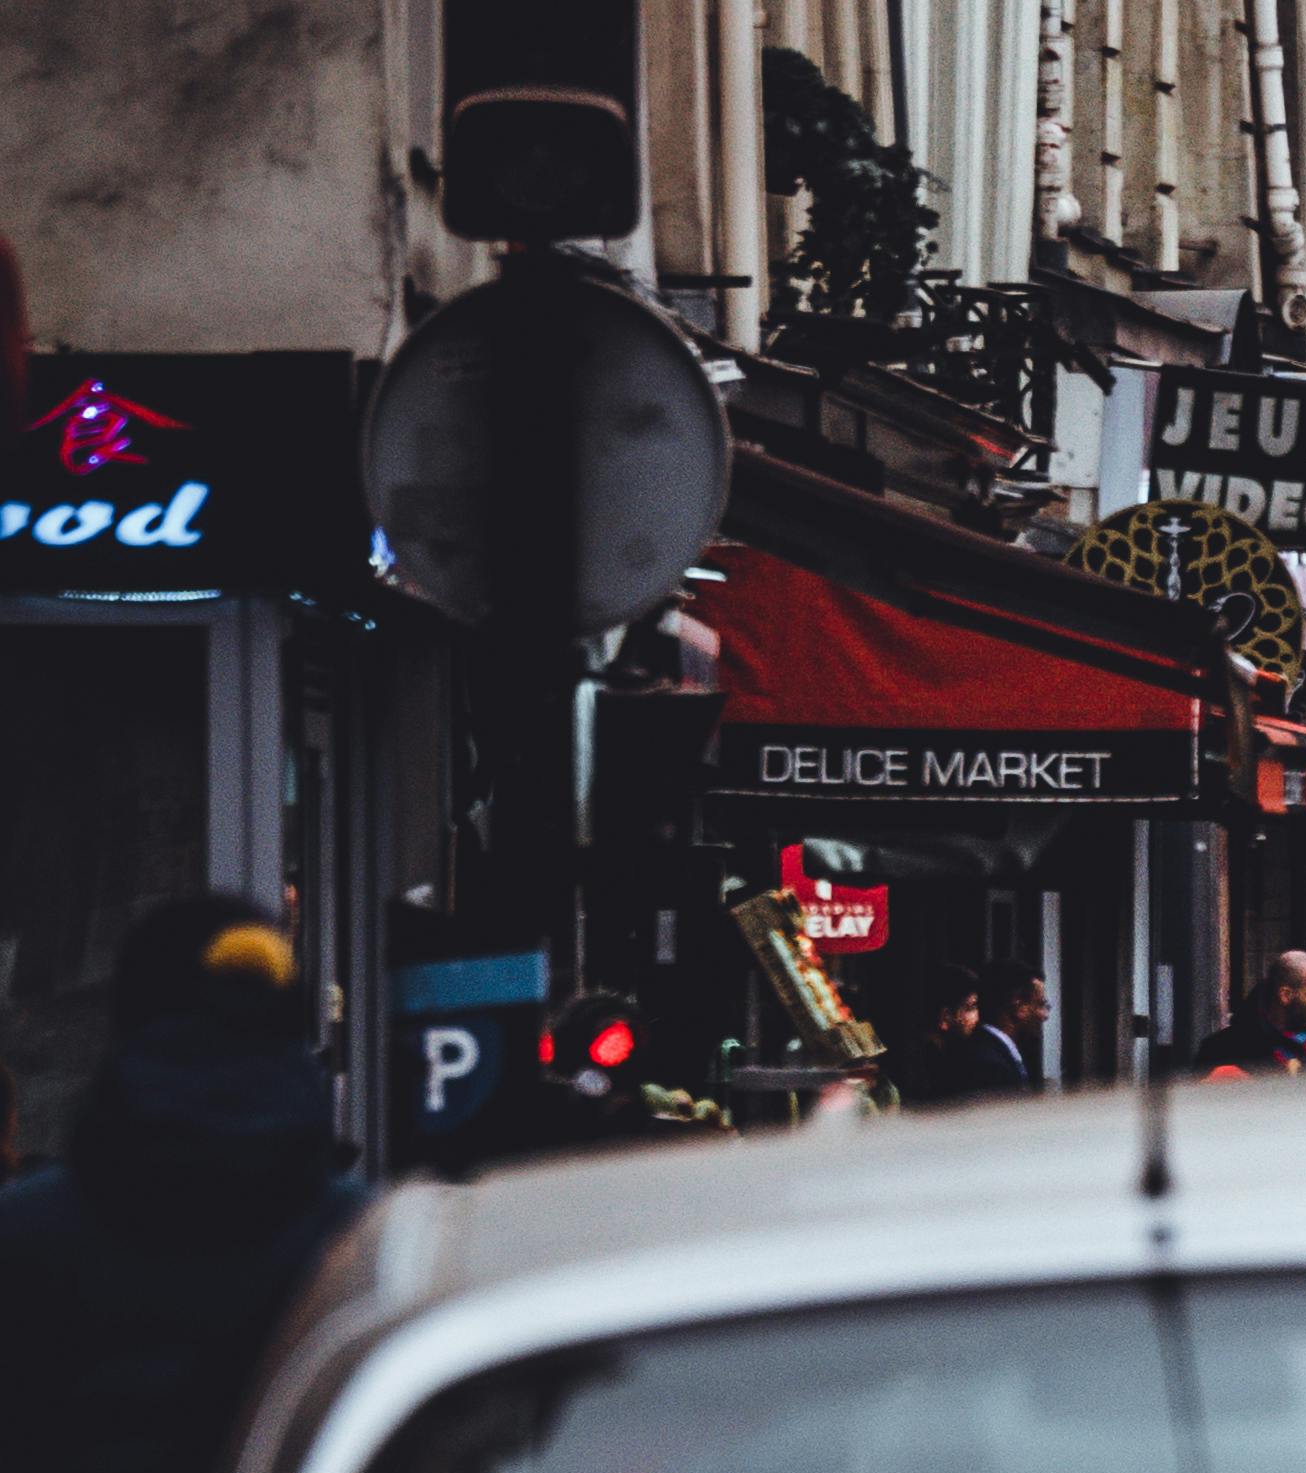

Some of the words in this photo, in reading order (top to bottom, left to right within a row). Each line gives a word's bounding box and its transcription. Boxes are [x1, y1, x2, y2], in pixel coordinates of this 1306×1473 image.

[762, 746, 908, 785] DELICE
[921, 750, 1111, 789] MARKET
[804, 915, 875, 938] ELAY
[424, 1026, 480, 1112] P
